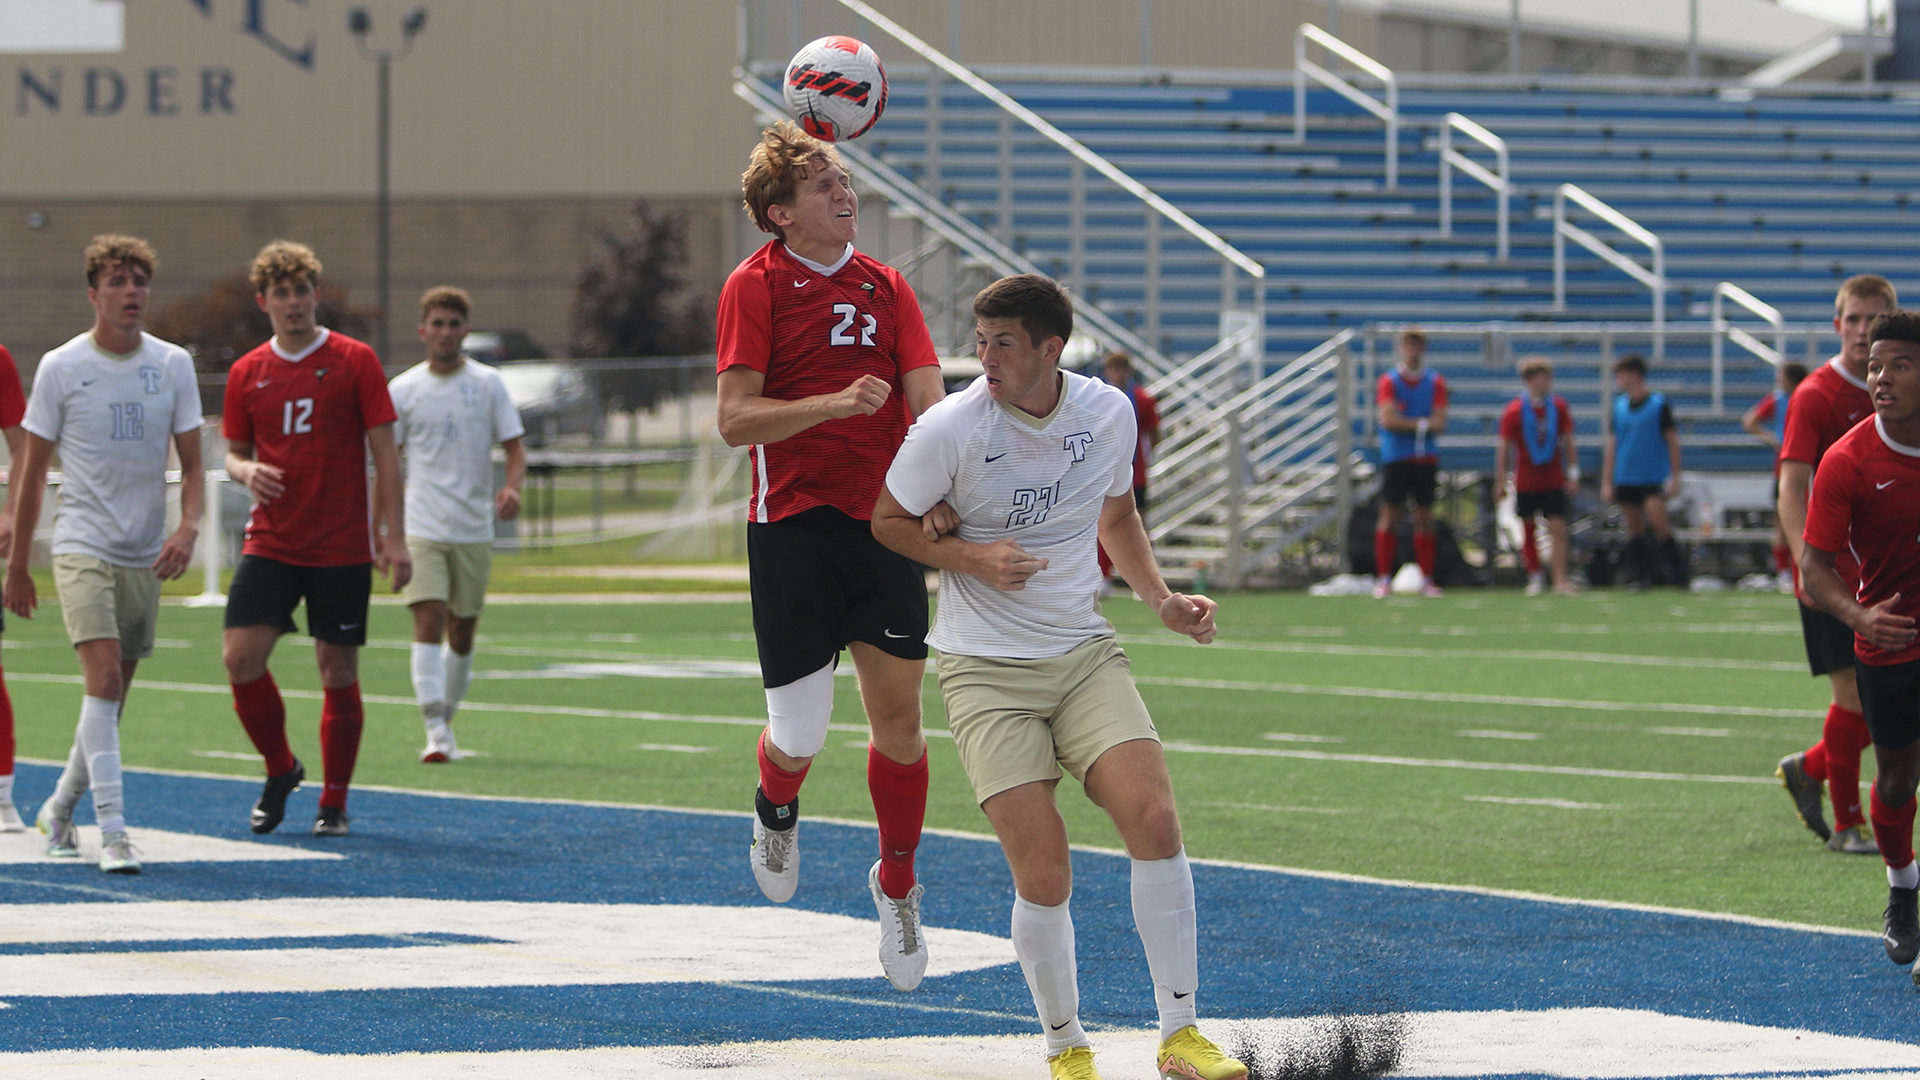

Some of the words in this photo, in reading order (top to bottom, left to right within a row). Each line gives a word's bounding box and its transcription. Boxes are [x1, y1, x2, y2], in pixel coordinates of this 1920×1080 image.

[16, 67, 237, 116] NDER
[139, 365, 161, 395] T
[109, 402, 144, 441] 12
[283, 397, 314, 435] 12
[1063, 431, 1094, 466] T
